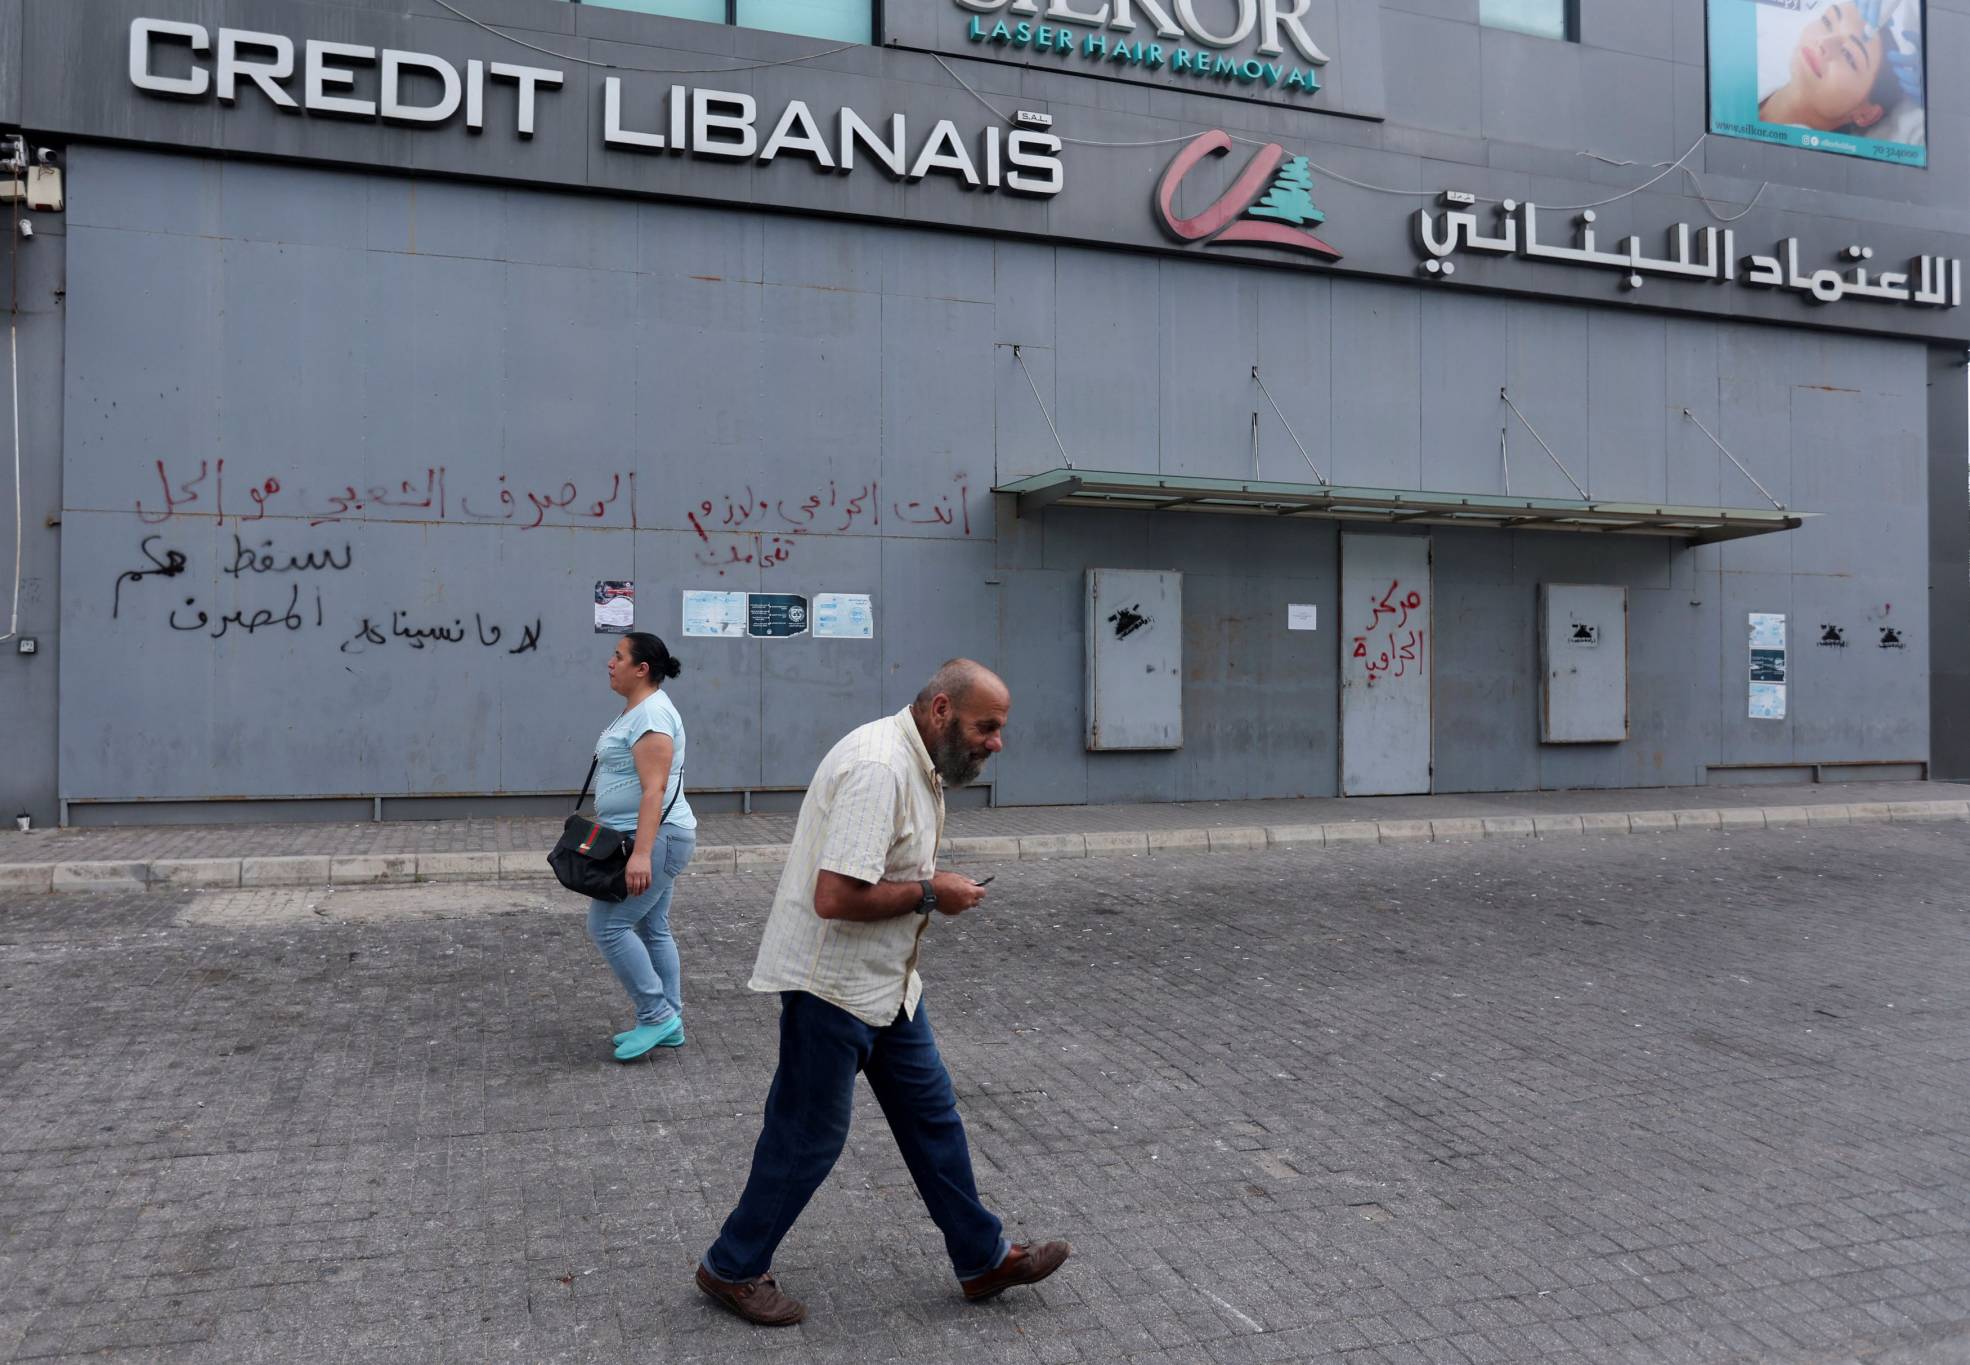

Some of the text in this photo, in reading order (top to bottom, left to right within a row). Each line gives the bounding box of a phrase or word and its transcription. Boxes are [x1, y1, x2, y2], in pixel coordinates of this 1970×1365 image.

[970, 15, 1322, 94] LASER HAIR REMOVAL
[129, 16, 1064, 195] CREDIT LIBANAIS
[1714, 121, 1788, 141] www.silkor.com
[1420, 198, 1961, 307] الاعتماد اللبناني
[1365, 579, 1422, 631] مركز
